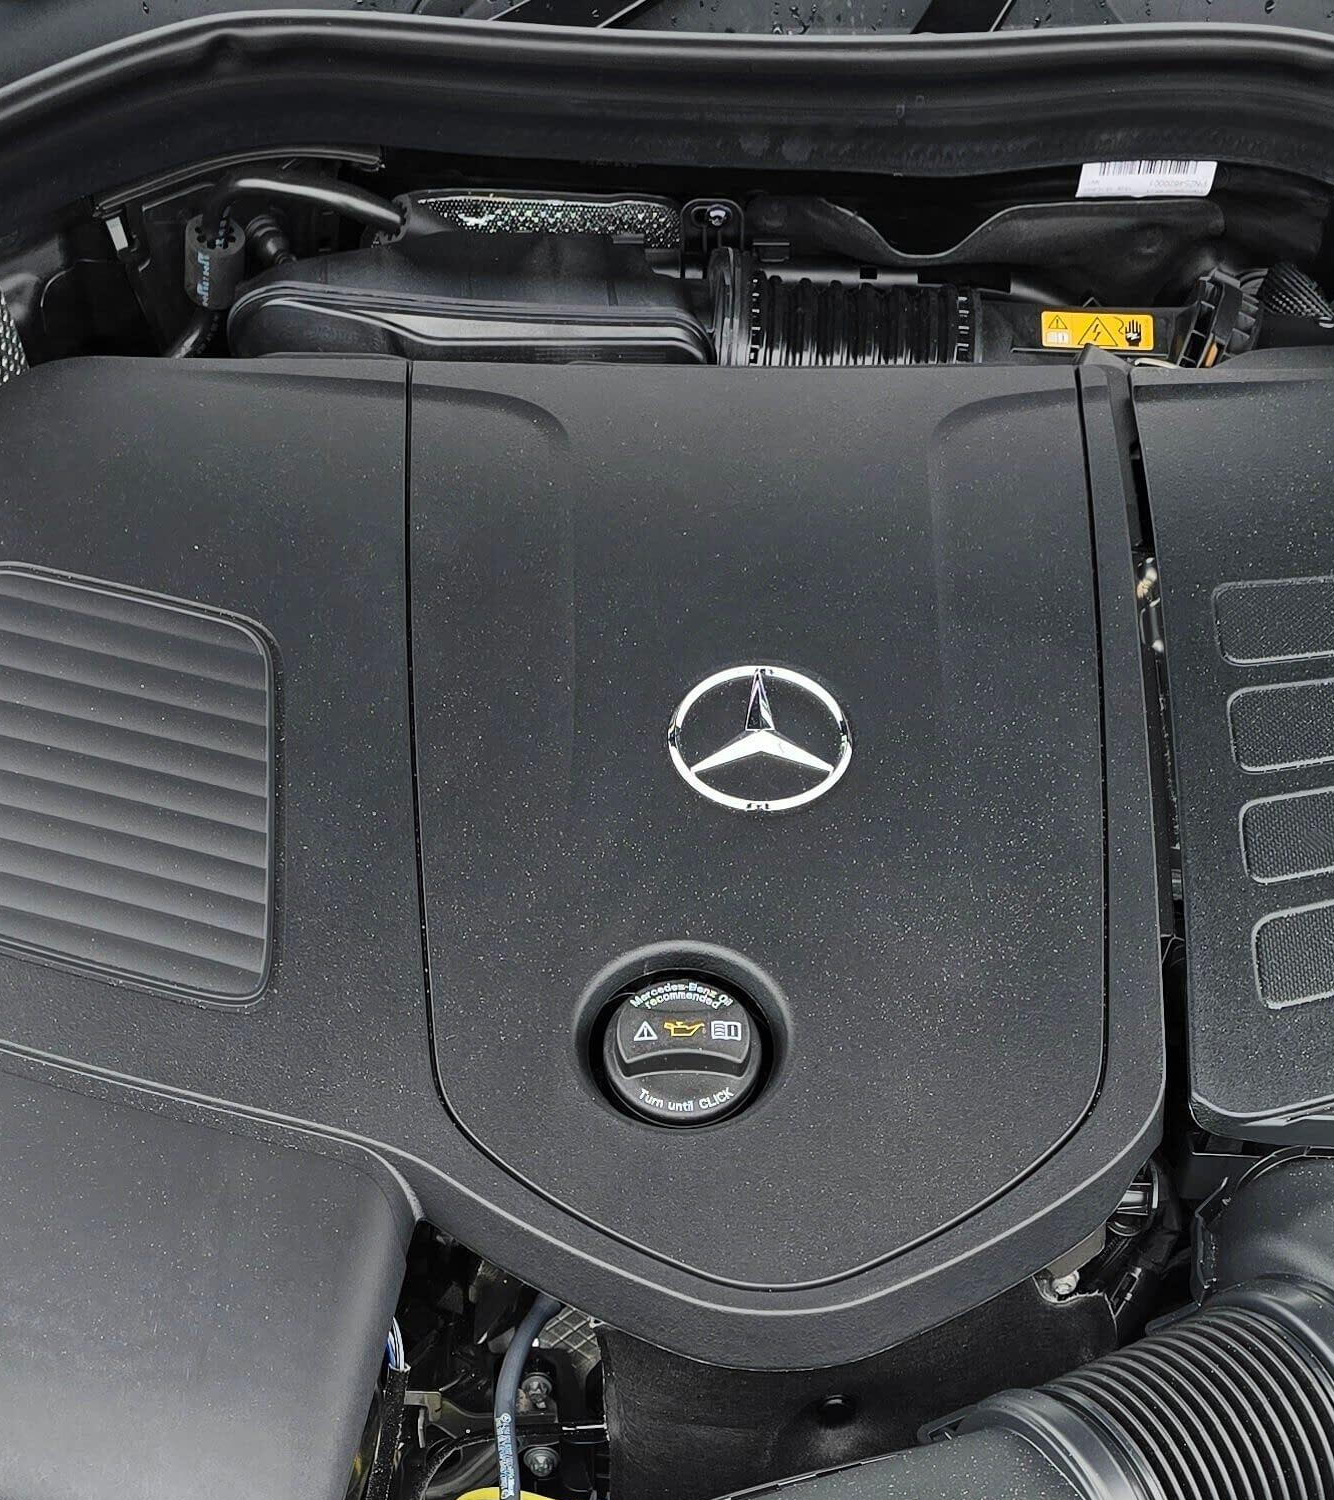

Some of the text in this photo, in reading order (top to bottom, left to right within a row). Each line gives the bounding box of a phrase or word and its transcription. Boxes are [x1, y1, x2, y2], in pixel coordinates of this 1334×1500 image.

[629, 982, 734, 1008] Mercedes-Benz Oil
[644, 990, 723, 1010] recommended
[638, 1086, 735, 1112] Turn until CLICK
